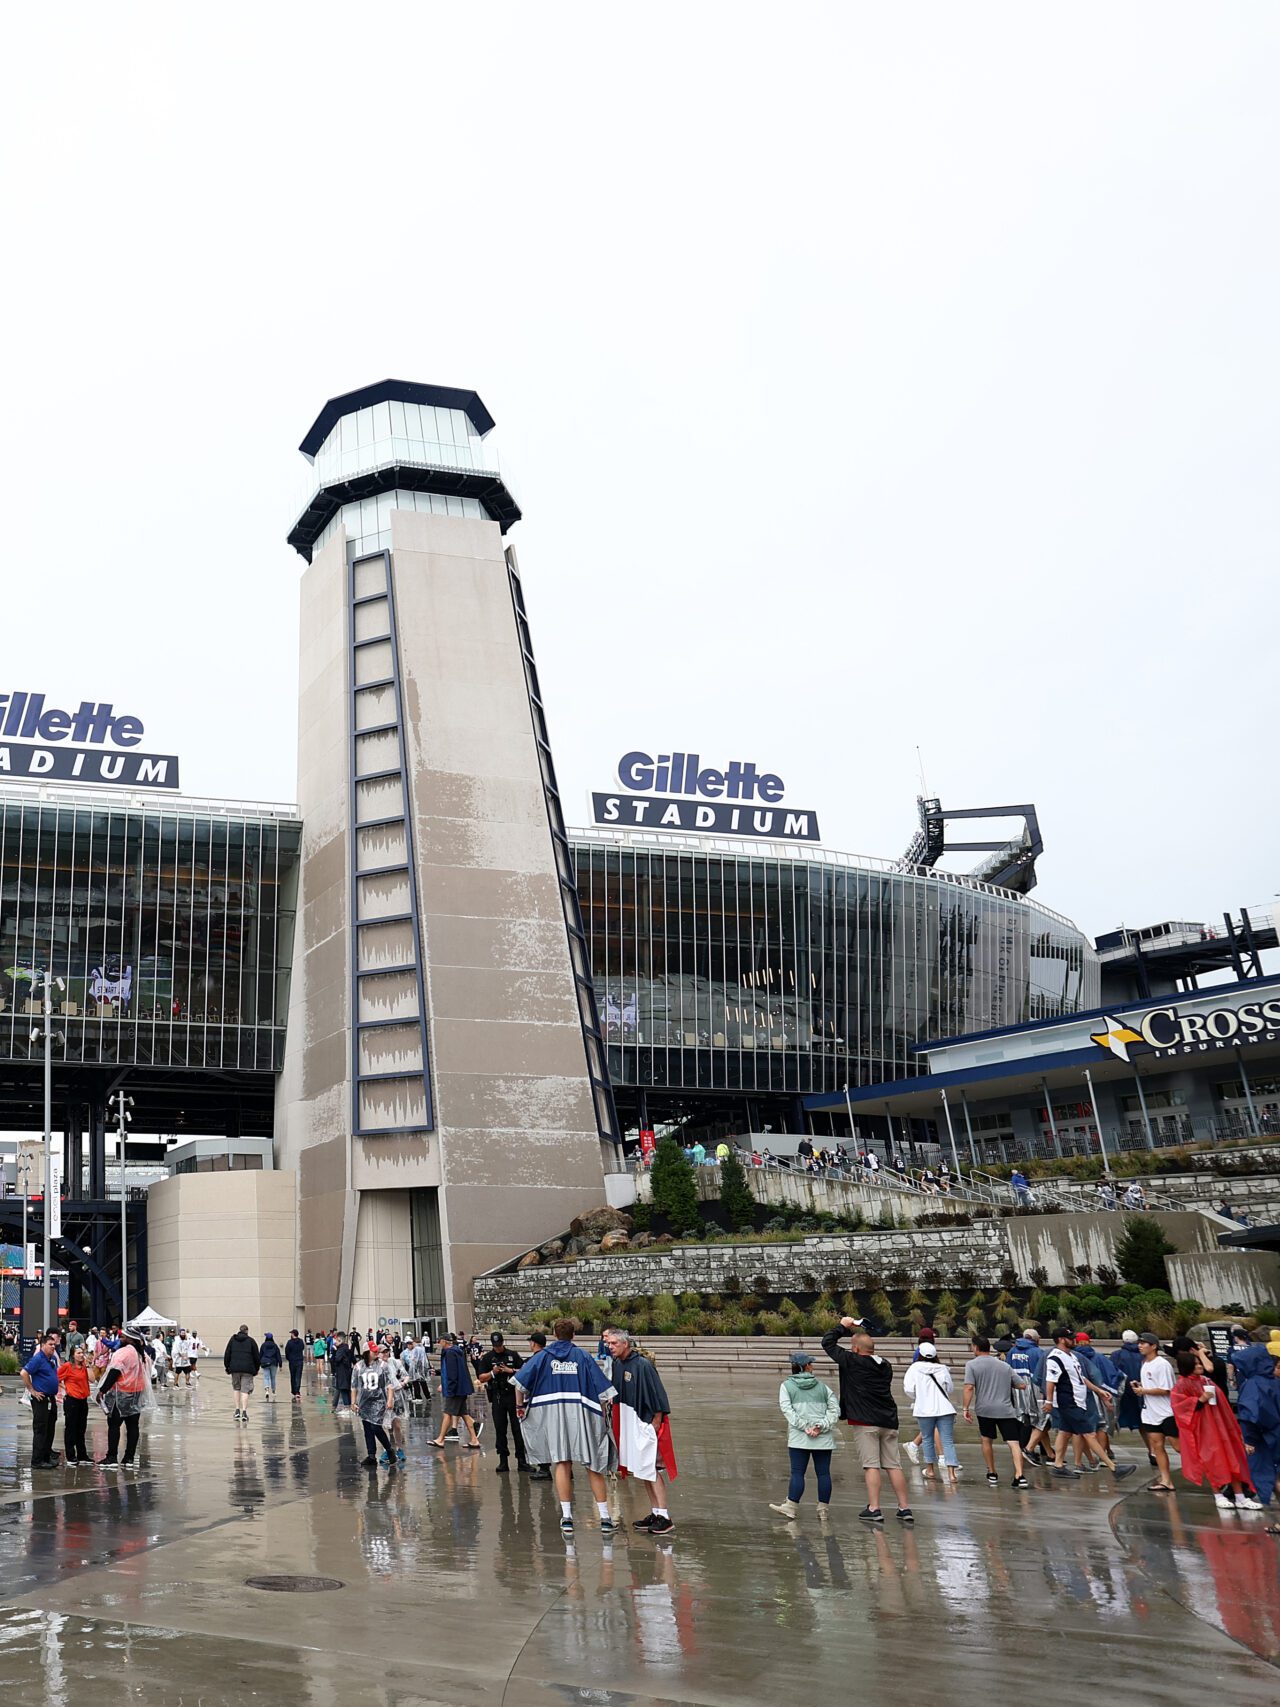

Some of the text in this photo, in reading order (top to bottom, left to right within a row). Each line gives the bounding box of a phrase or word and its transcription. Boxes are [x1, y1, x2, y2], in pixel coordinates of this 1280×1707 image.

[618, 751, 785, 802] Gillette
[603, 798, 809, 836] STADIUM
[1141, 1001, 1280, 1048] CROSS
[1154, 1032, 1276, 1058] INSURANC
[388, 1318, 400, 1326] GP
[361, 1372, 379, 1390] 10
